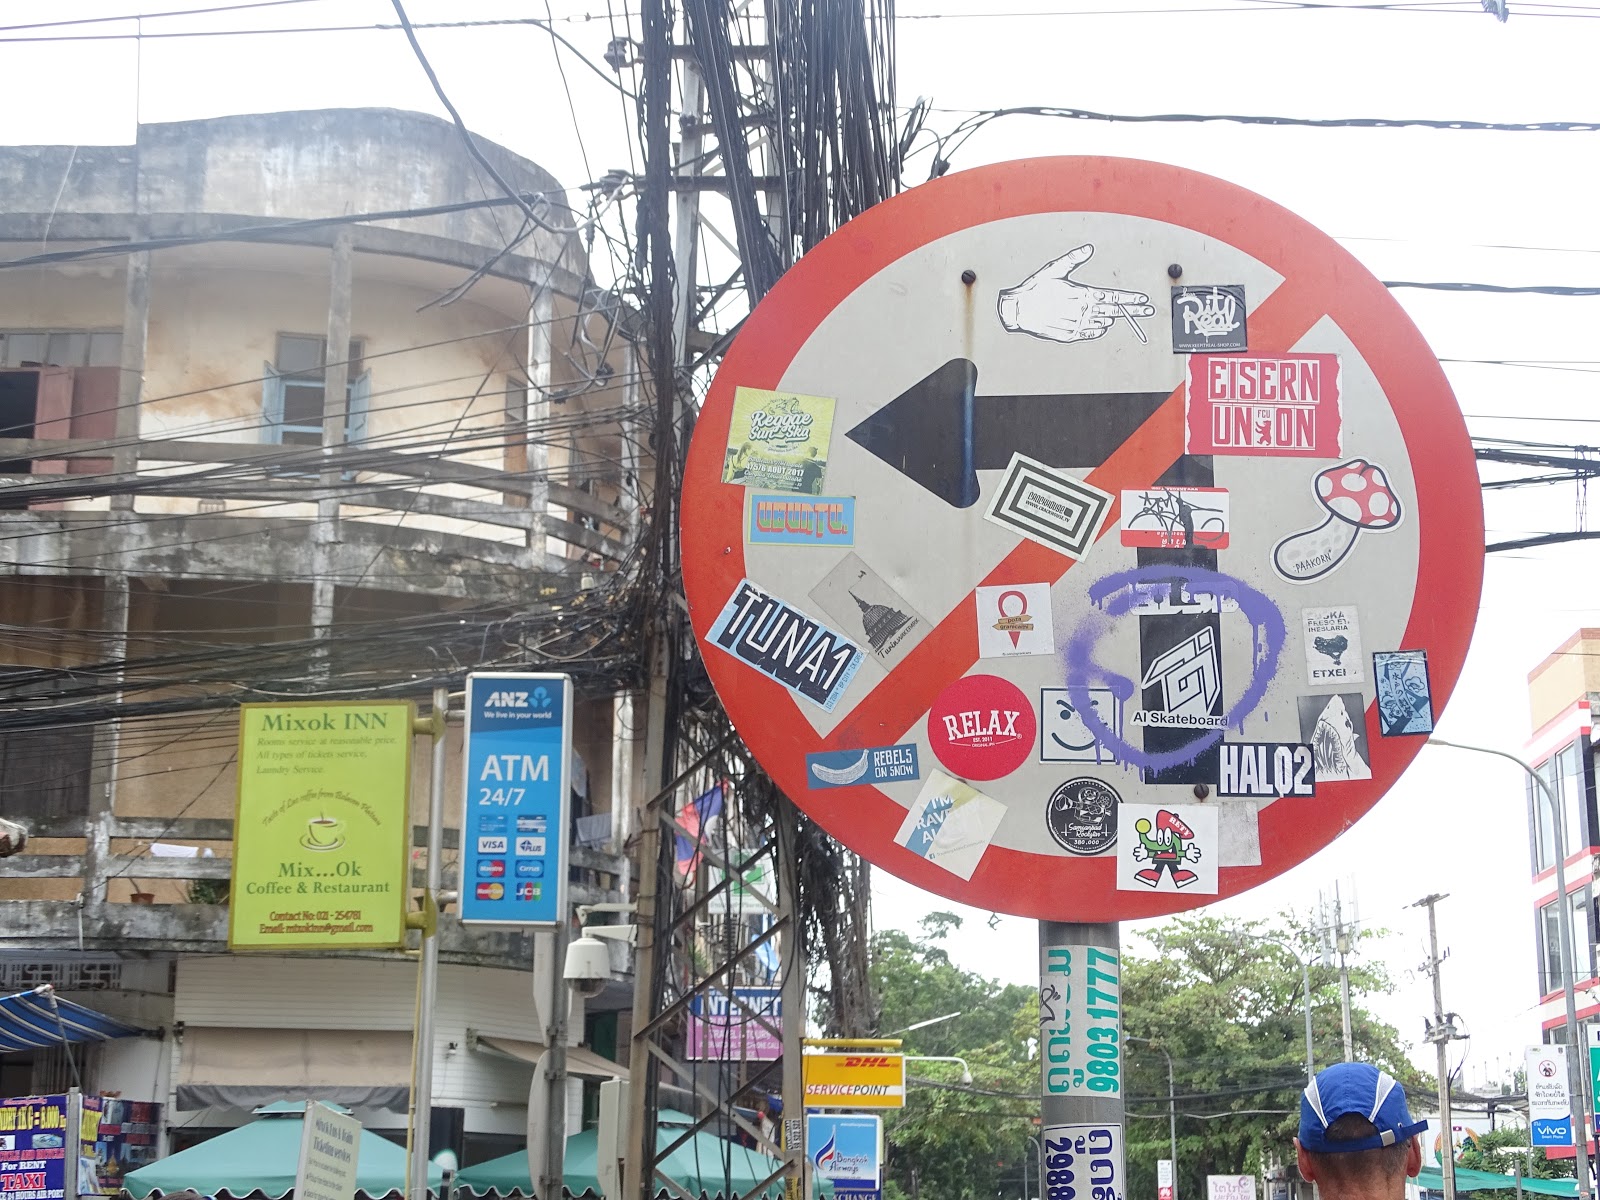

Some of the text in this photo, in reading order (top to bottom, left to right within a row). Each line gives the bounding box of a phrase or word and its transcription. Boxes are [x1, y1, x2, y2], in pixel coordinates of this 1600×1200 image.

[1208, 360, 1319, 402] EISERN
[750, 409, 813, 433] Reggae
[787, 467, 805, 478] 2017
[484, 691, 529, 708] ANZ
[483, 711, 552, 720] We live in your world
[1150, 712, 1228, 727] Skateboard
[261, 712, 389, 732] Mixok INN
[942, 709, 1020, 742] RELAX
[256, 737, 286, 746] Rooms
[288, 738, 317, 746] service
[319, 737, 328, 746] at
[329, 736, 373, 745] reasonable
[255, 751, 270, 760] All
[272, 751, 294, 761] types
[296, 750, 306, 760] of
[307, 750, 334, 760] tickets
[873, 748, 913, 767] REBELS
[255, 765, 291, 776] Laundry
[480, 754, 549, 781] ATM
[875, 765, 914, 779] ON SNOW
[478, 787, 526, 806] 24/7
[482, 840, 504, 849] VISA
[525, 844, 542, 852] PLUS
[246, 881, 391, 894] Coffee & Restaurant
[516, 887, 541, 896] JCB
[269, 910, 302, 921] Contact
[844, 1057, 891, 1068] DHL
[806, 1084, 890, 1096] SERVICEPOINT
[1537, 1125, 1567, 1135] vivo
[836, 1152, 868, 1165] Bangkok
[1, 1160, 47, 1171] For RENT
[829, 1160, 859, 1174] Airways
[1, 1172, 47, 1191] TAXI
[15, 1190, 36, 1200] HOURS
[48, 1189, 65, 1198] PORT
